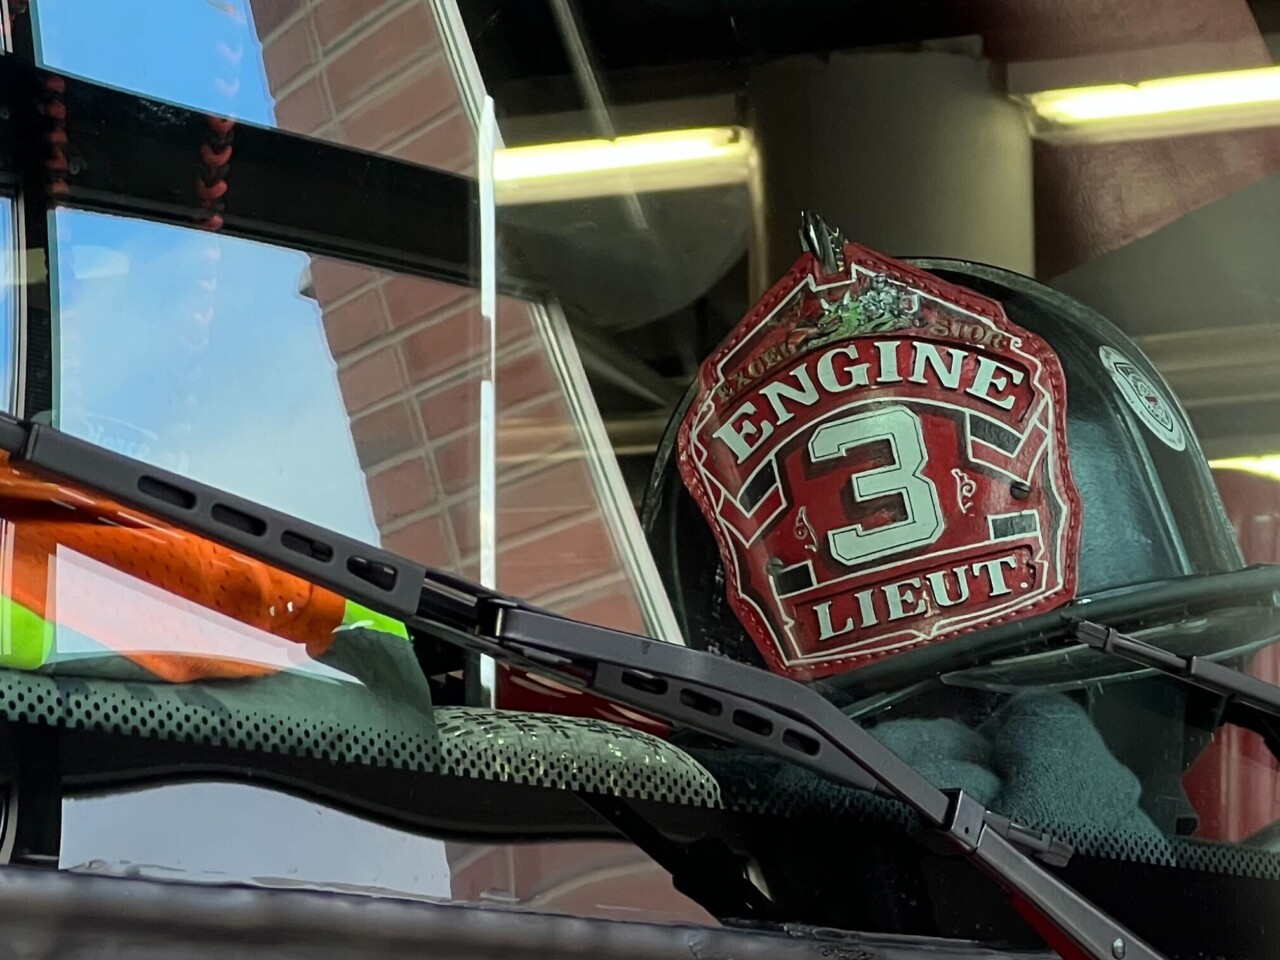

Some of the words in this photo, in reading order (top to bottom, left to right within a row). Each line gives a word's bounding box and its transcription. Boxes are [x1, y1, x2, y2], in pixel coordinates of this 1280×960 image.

[711, 340, 1025, 464] ENGINE
[808, 403, 945, 568] 3
[812, 555, 1029, 642] LIEUT.
